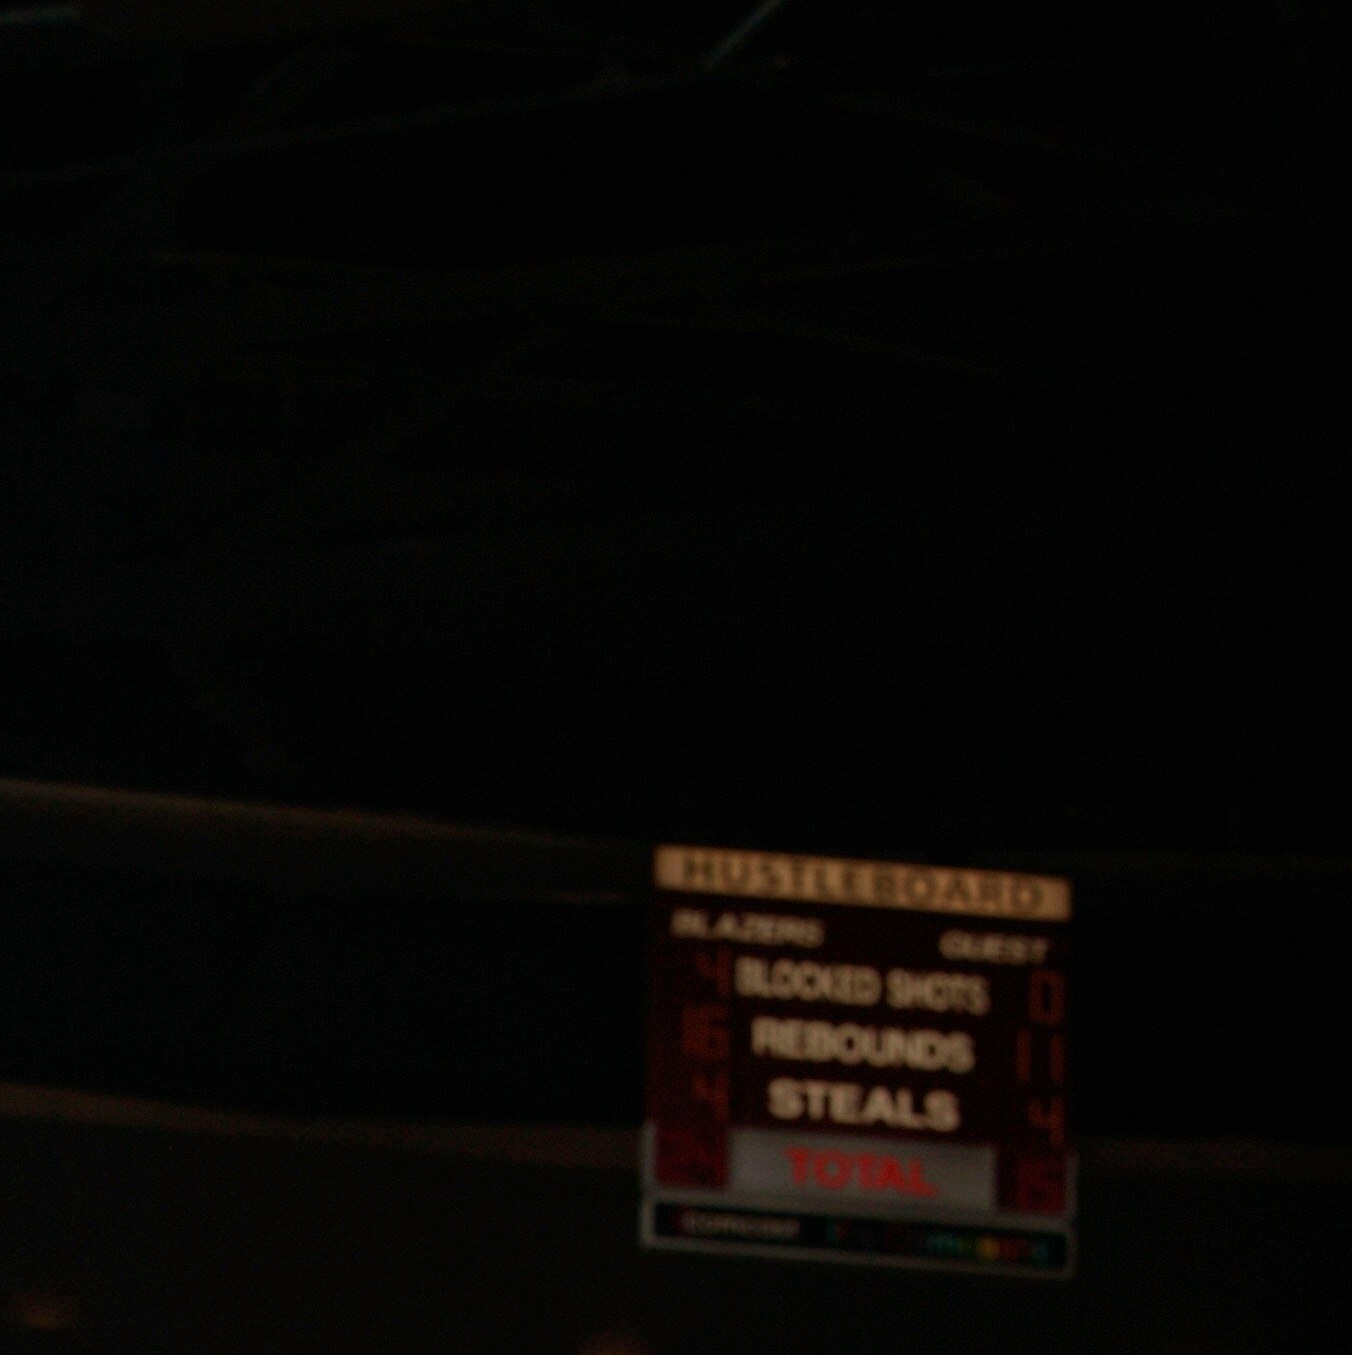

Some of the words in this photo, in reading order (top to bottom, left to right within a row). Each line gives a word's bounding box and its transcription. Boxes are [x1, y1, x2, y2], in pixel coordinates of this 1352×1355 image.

[682, 856, 1042, 910] HUSTLEBOARD
[667, 906, 825, 949] BLAZERS
[938, 928, 1051, 965] GUEST
[734, 955, 882, 1006] BLOCKED
[886, 966, 991, 1016] SHOTS
[751, 1015, 976, 1074] REBOUNDS
[766, 1076, 961, 1132] STEALS
[785, 1146, 939, 1197] TOTAL
